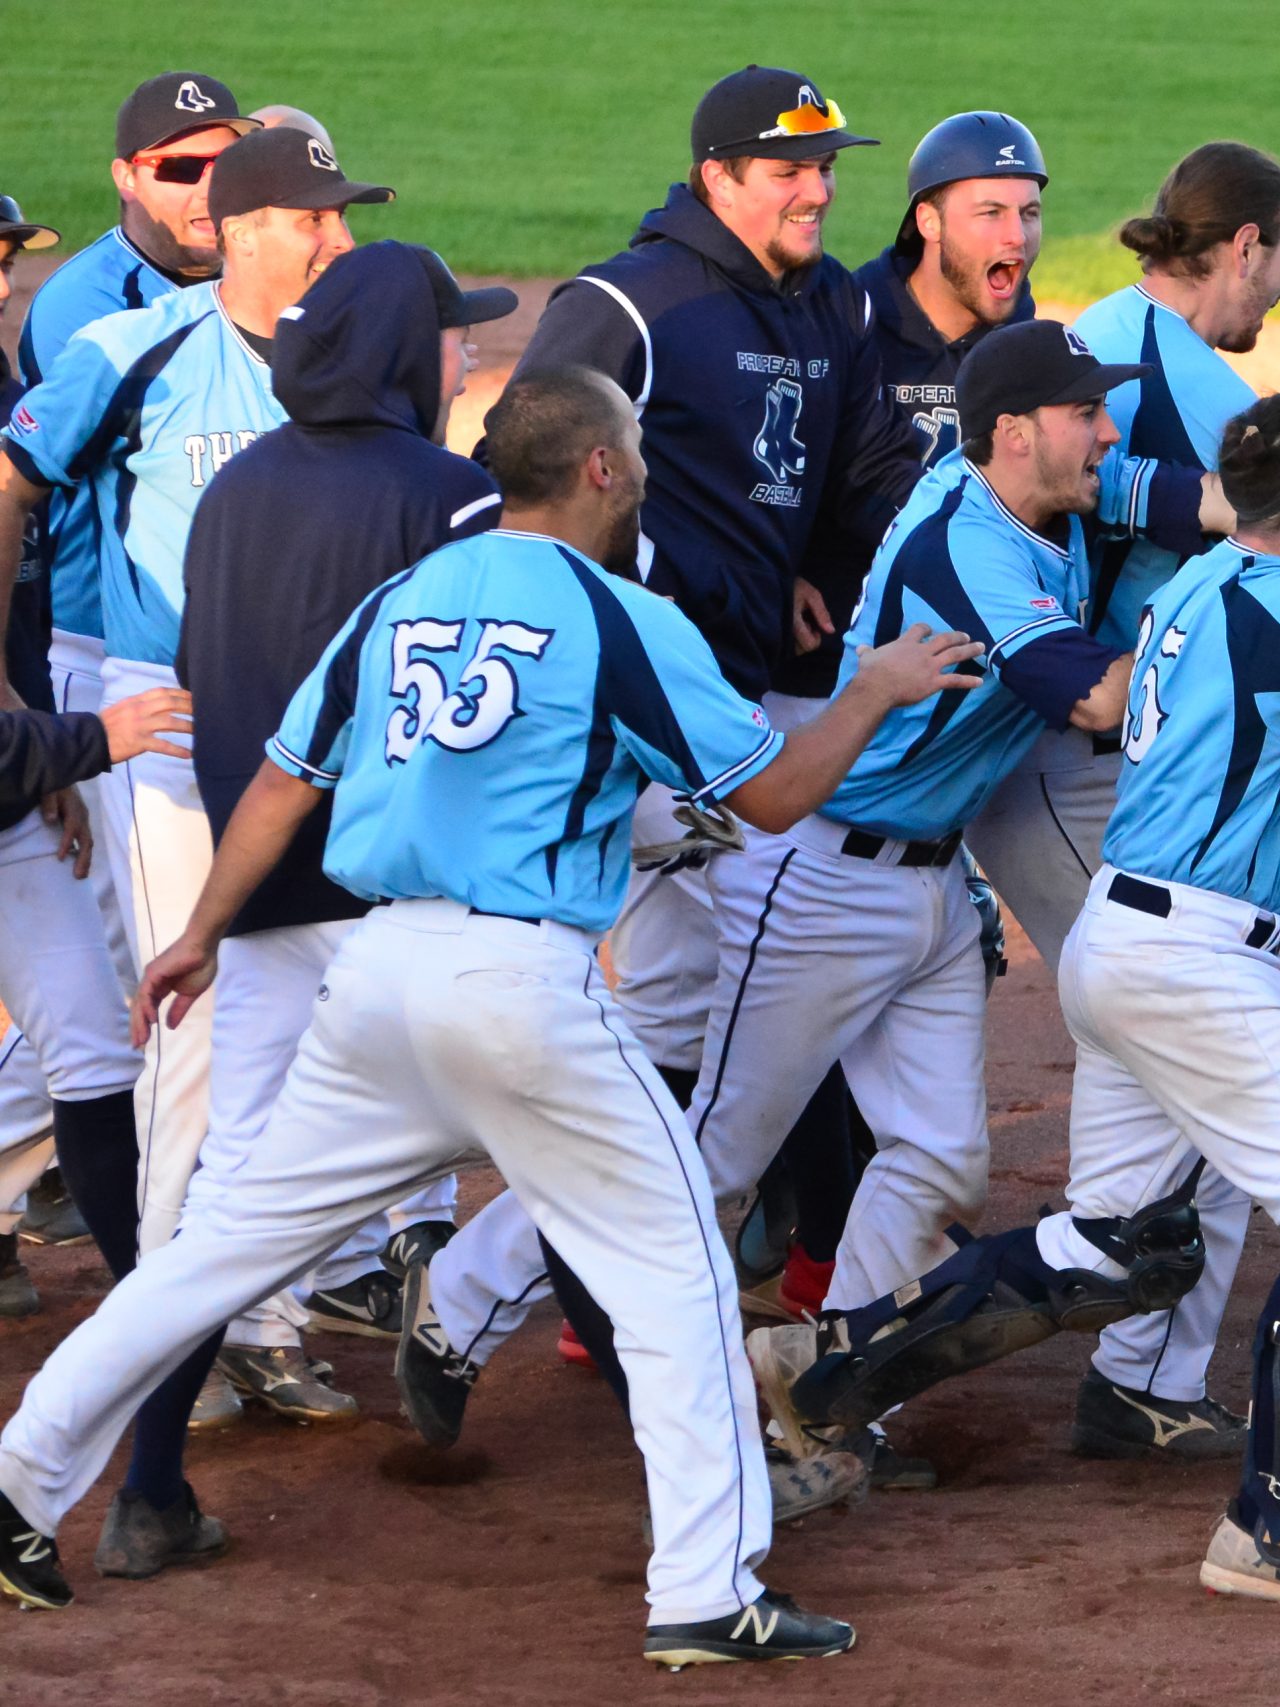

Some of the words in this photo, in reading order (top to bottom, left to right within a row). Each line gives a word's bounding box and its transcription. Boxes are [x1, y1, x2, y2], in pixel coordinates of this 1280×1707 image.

[737, 352, 800, 377] PROPER
[807, 358, 829, 378] OF
[384, 616, 556, 770] 55
